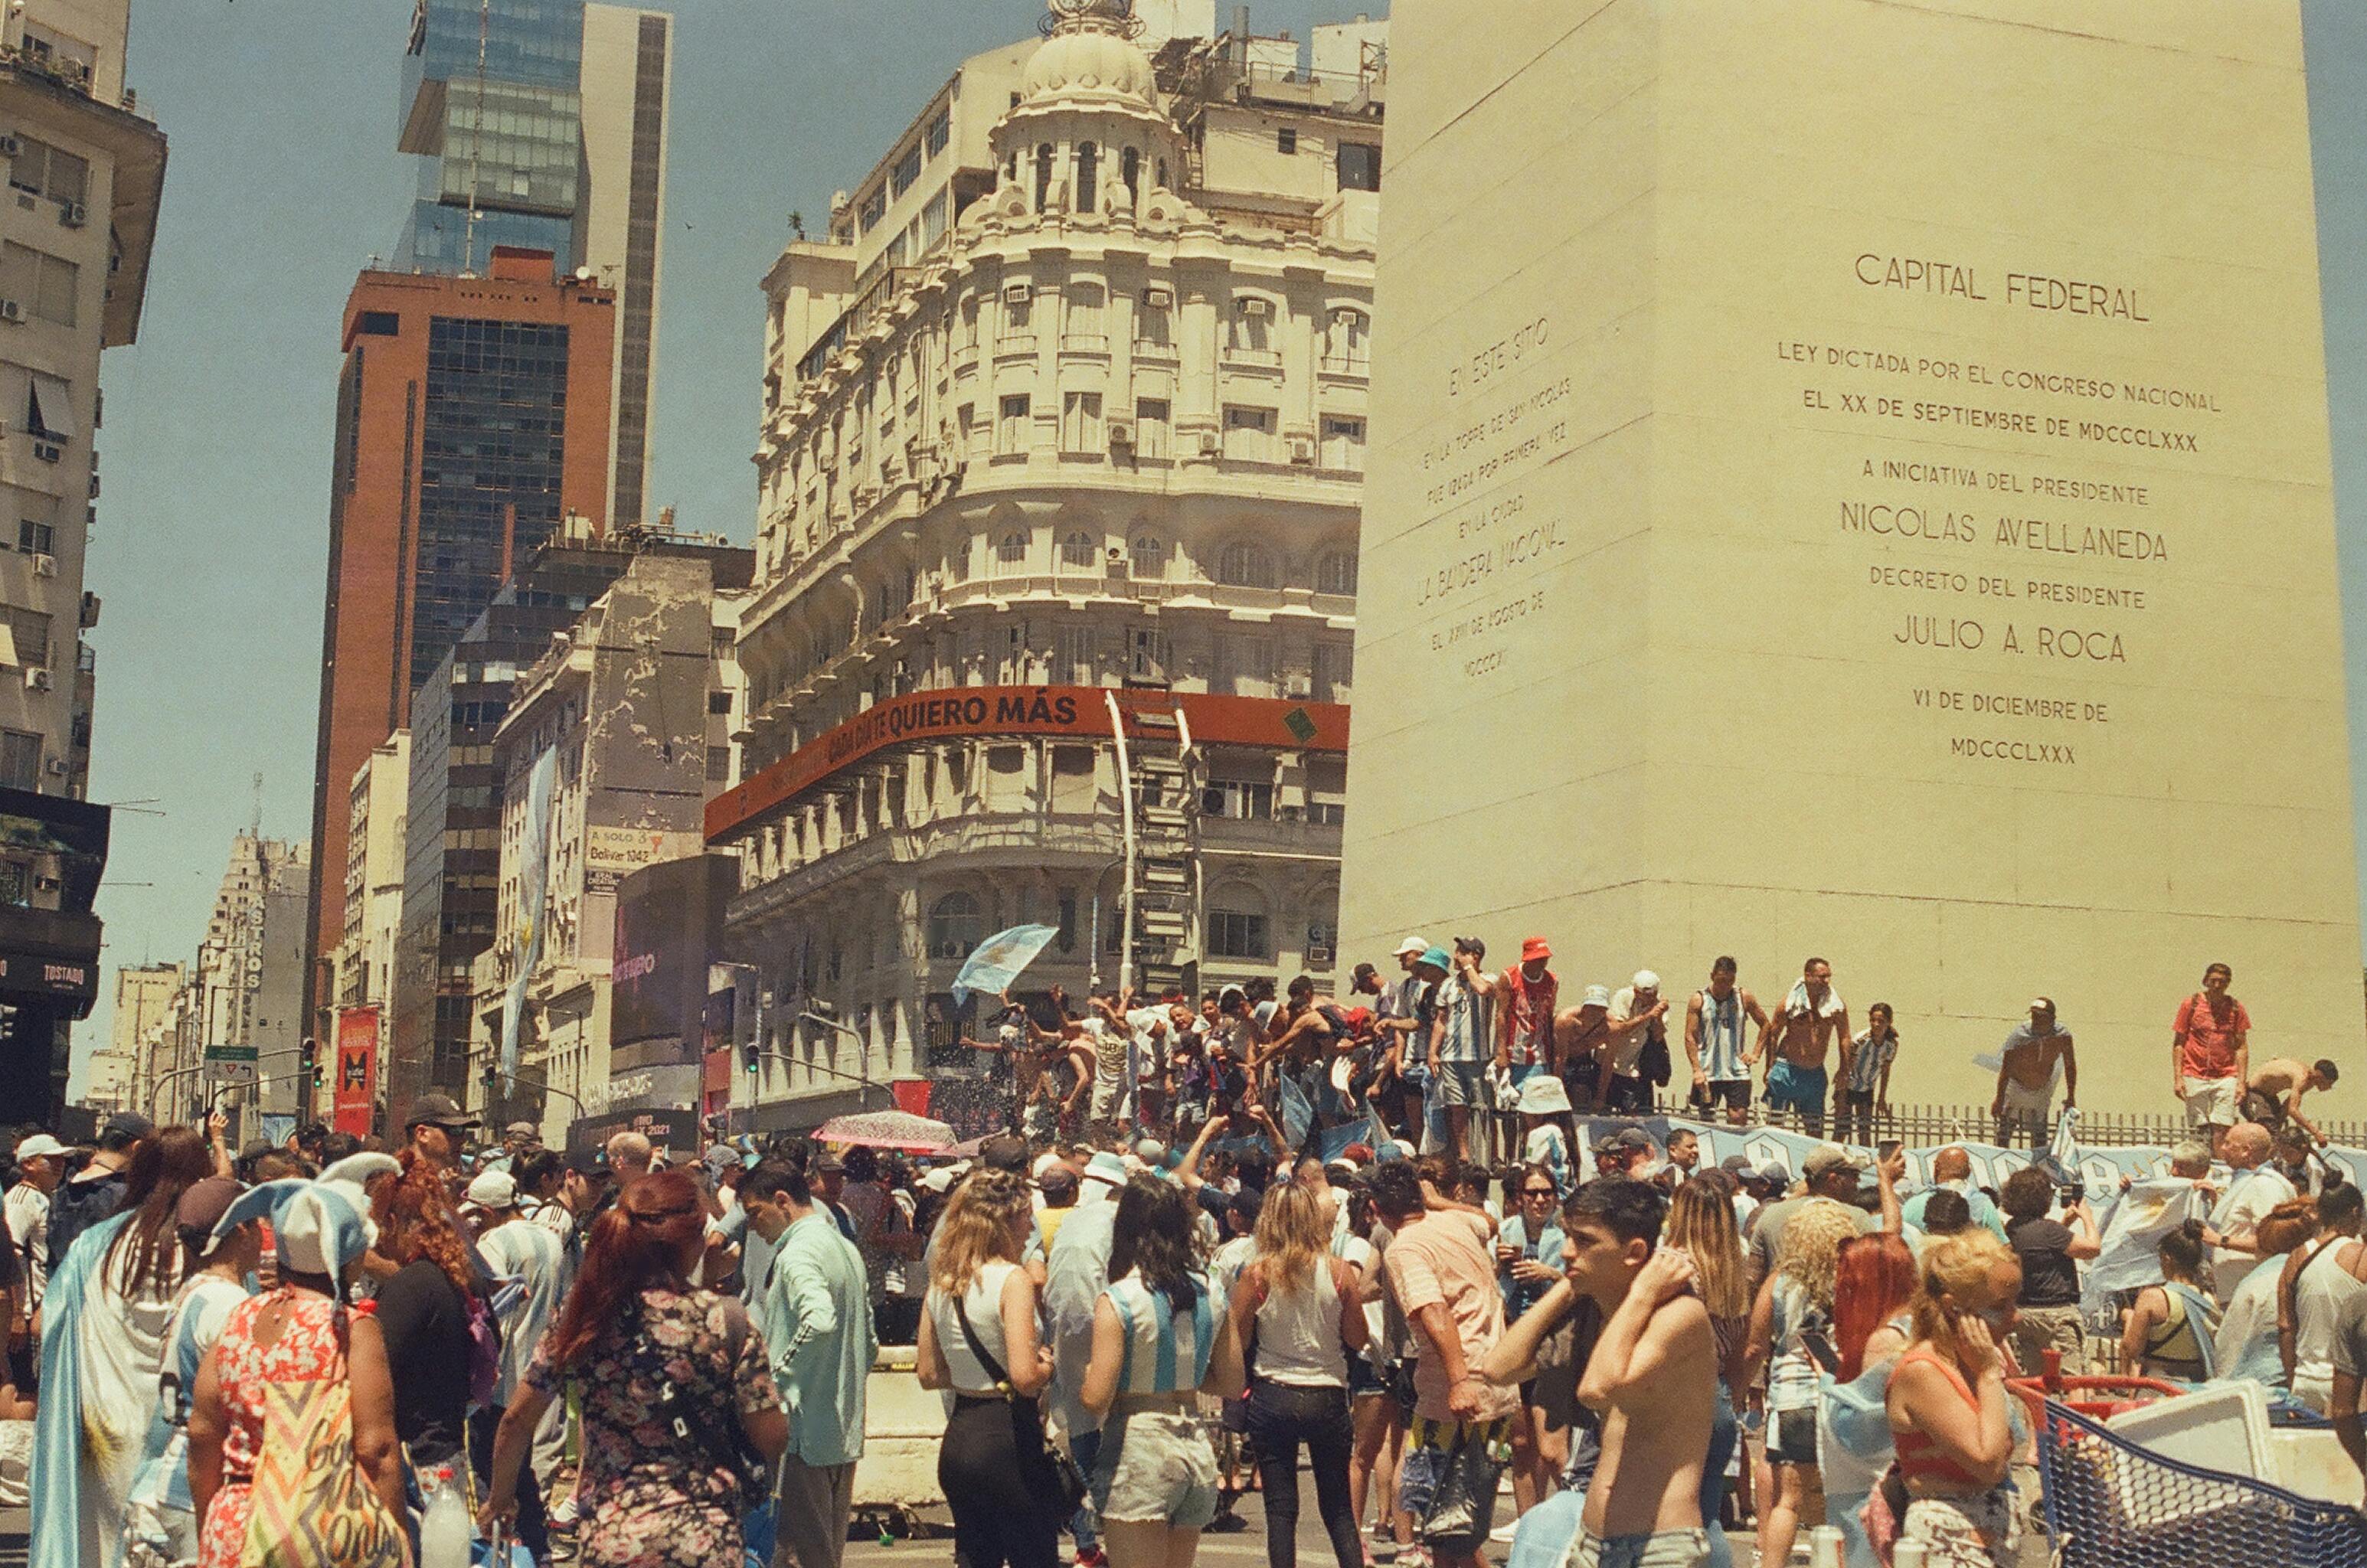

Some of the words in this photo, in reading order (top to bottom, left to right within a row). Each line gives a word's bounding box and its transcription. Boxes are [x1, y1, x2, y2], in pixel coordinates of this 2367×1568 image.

[1855, 253, 1986, 300] CAPITAL
[2007, 273, 2150, 322] FEDERAL
[1778, 341, 1818, 362] LEY
[1827, 348, 1910, 374] DICTADA
[1918, 358, 1960, 381] POR
[1968, 364, 1993, 384] EL
[2002, 370, 2116, 400] CONGRESO
[2124, 384, 2221, 412] NACIONAL
[1803, 390, 1829, 410] EL
[1840, 394, 1868, 413] XX
[1878, 399, 1904, 417] DE
[1914, 403, 2036, 434] SEPTIEMBRE
[2046, 417, 2070, 437] DE
[2078, 422, 2199, 452] MDCCCLXXX
[1862, 459, 1873, 476] A
[1883, 461, 1978, 487] INICIATIVA
[1986, 472, 2024, 493] DEL
[2032, 477, 2149, 505] PRESIDENTE
[1841, 501, 1976, 542] NICOLAS
[1995, 518, 2167, 562] AVELLANEDA
[1870, 566, 1967, 592] DECRETO
[1979, 577, 2016, 597] DEL
[2028, 581, 2145, 609] PRESIDENTE
[1895, 613, 1984, 650] JULIO
[2002, 624, 2024, 654] A.
[2038, 627, 2126, 663] ROCA
[889, 696, 987, 736] QUIERO
[996, 687, 1077, 724] MÁS
[1913, 688, 1931, 707] VI
[1939, 691, 1964, 711] DE
[1973, 693, 2077, 720] DICIEMBRE
[2084, 703, 2107, 722] DE
[1950, 737, 2075, 764] MDCCCLXXX
[604, 832, 633, 842] SOLO
[44, 964, 84, 985] TOSTADO
